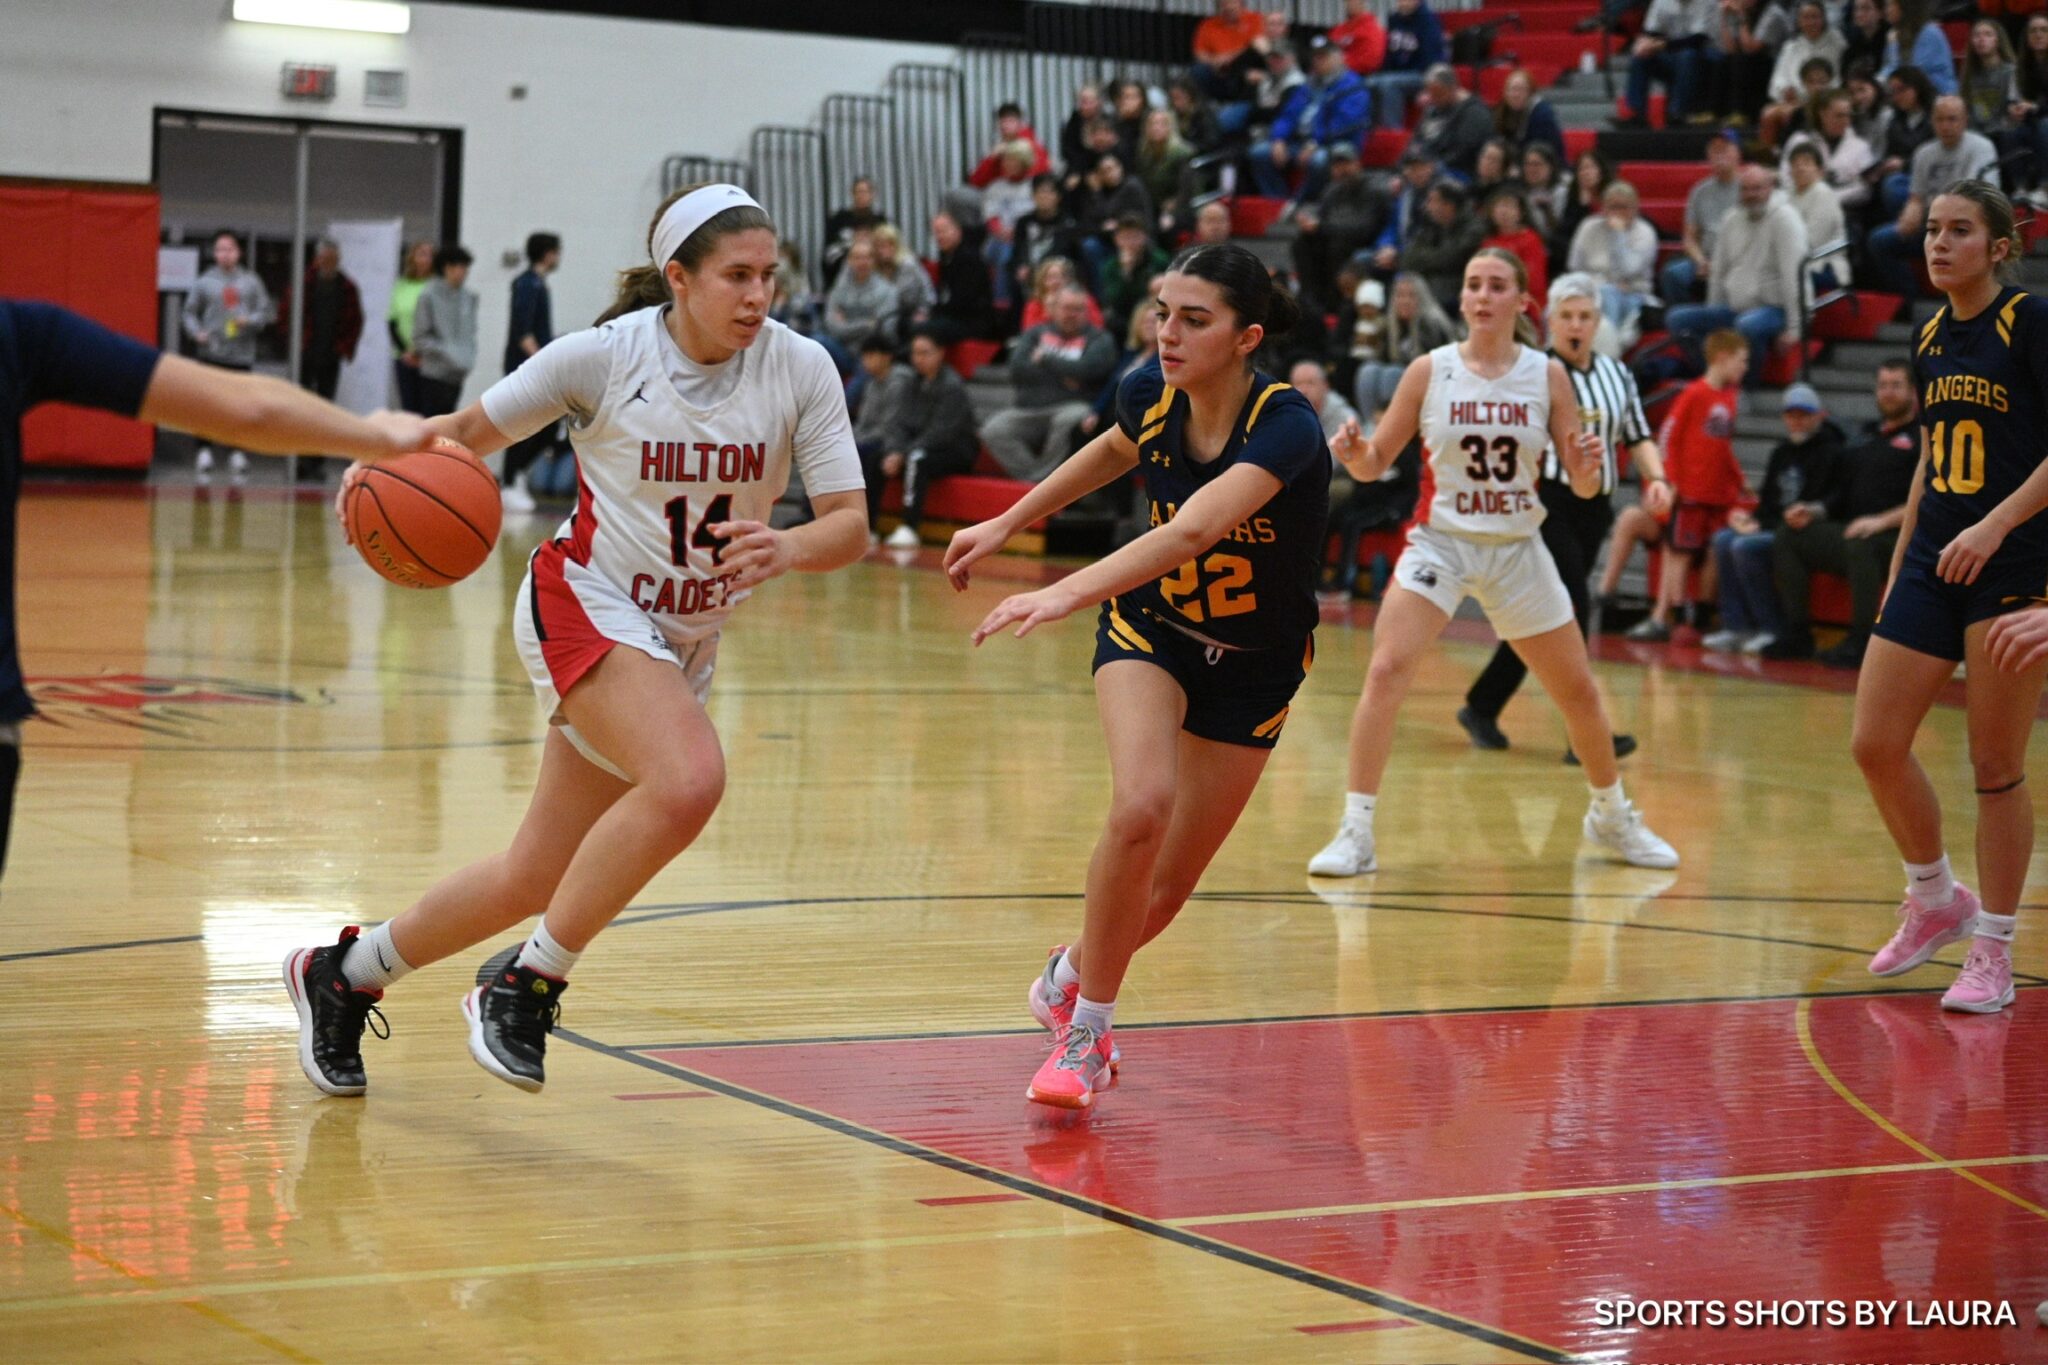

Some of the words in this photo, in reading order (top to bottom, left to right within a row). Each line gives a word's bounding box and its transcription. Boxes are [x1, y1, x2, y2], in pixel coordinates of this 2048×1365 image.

[1450, 401, 1529, 427] HILTON
[1925, 374, 2009, 413] ANGERS
[640, 441, 766, 483] HILTON
[1460, 434, 1519, 483] 33
[1931, 419, 1985, 494] 10
[664, 494, 734, 568] 14
[1160, 552, 1257, 623] 22
